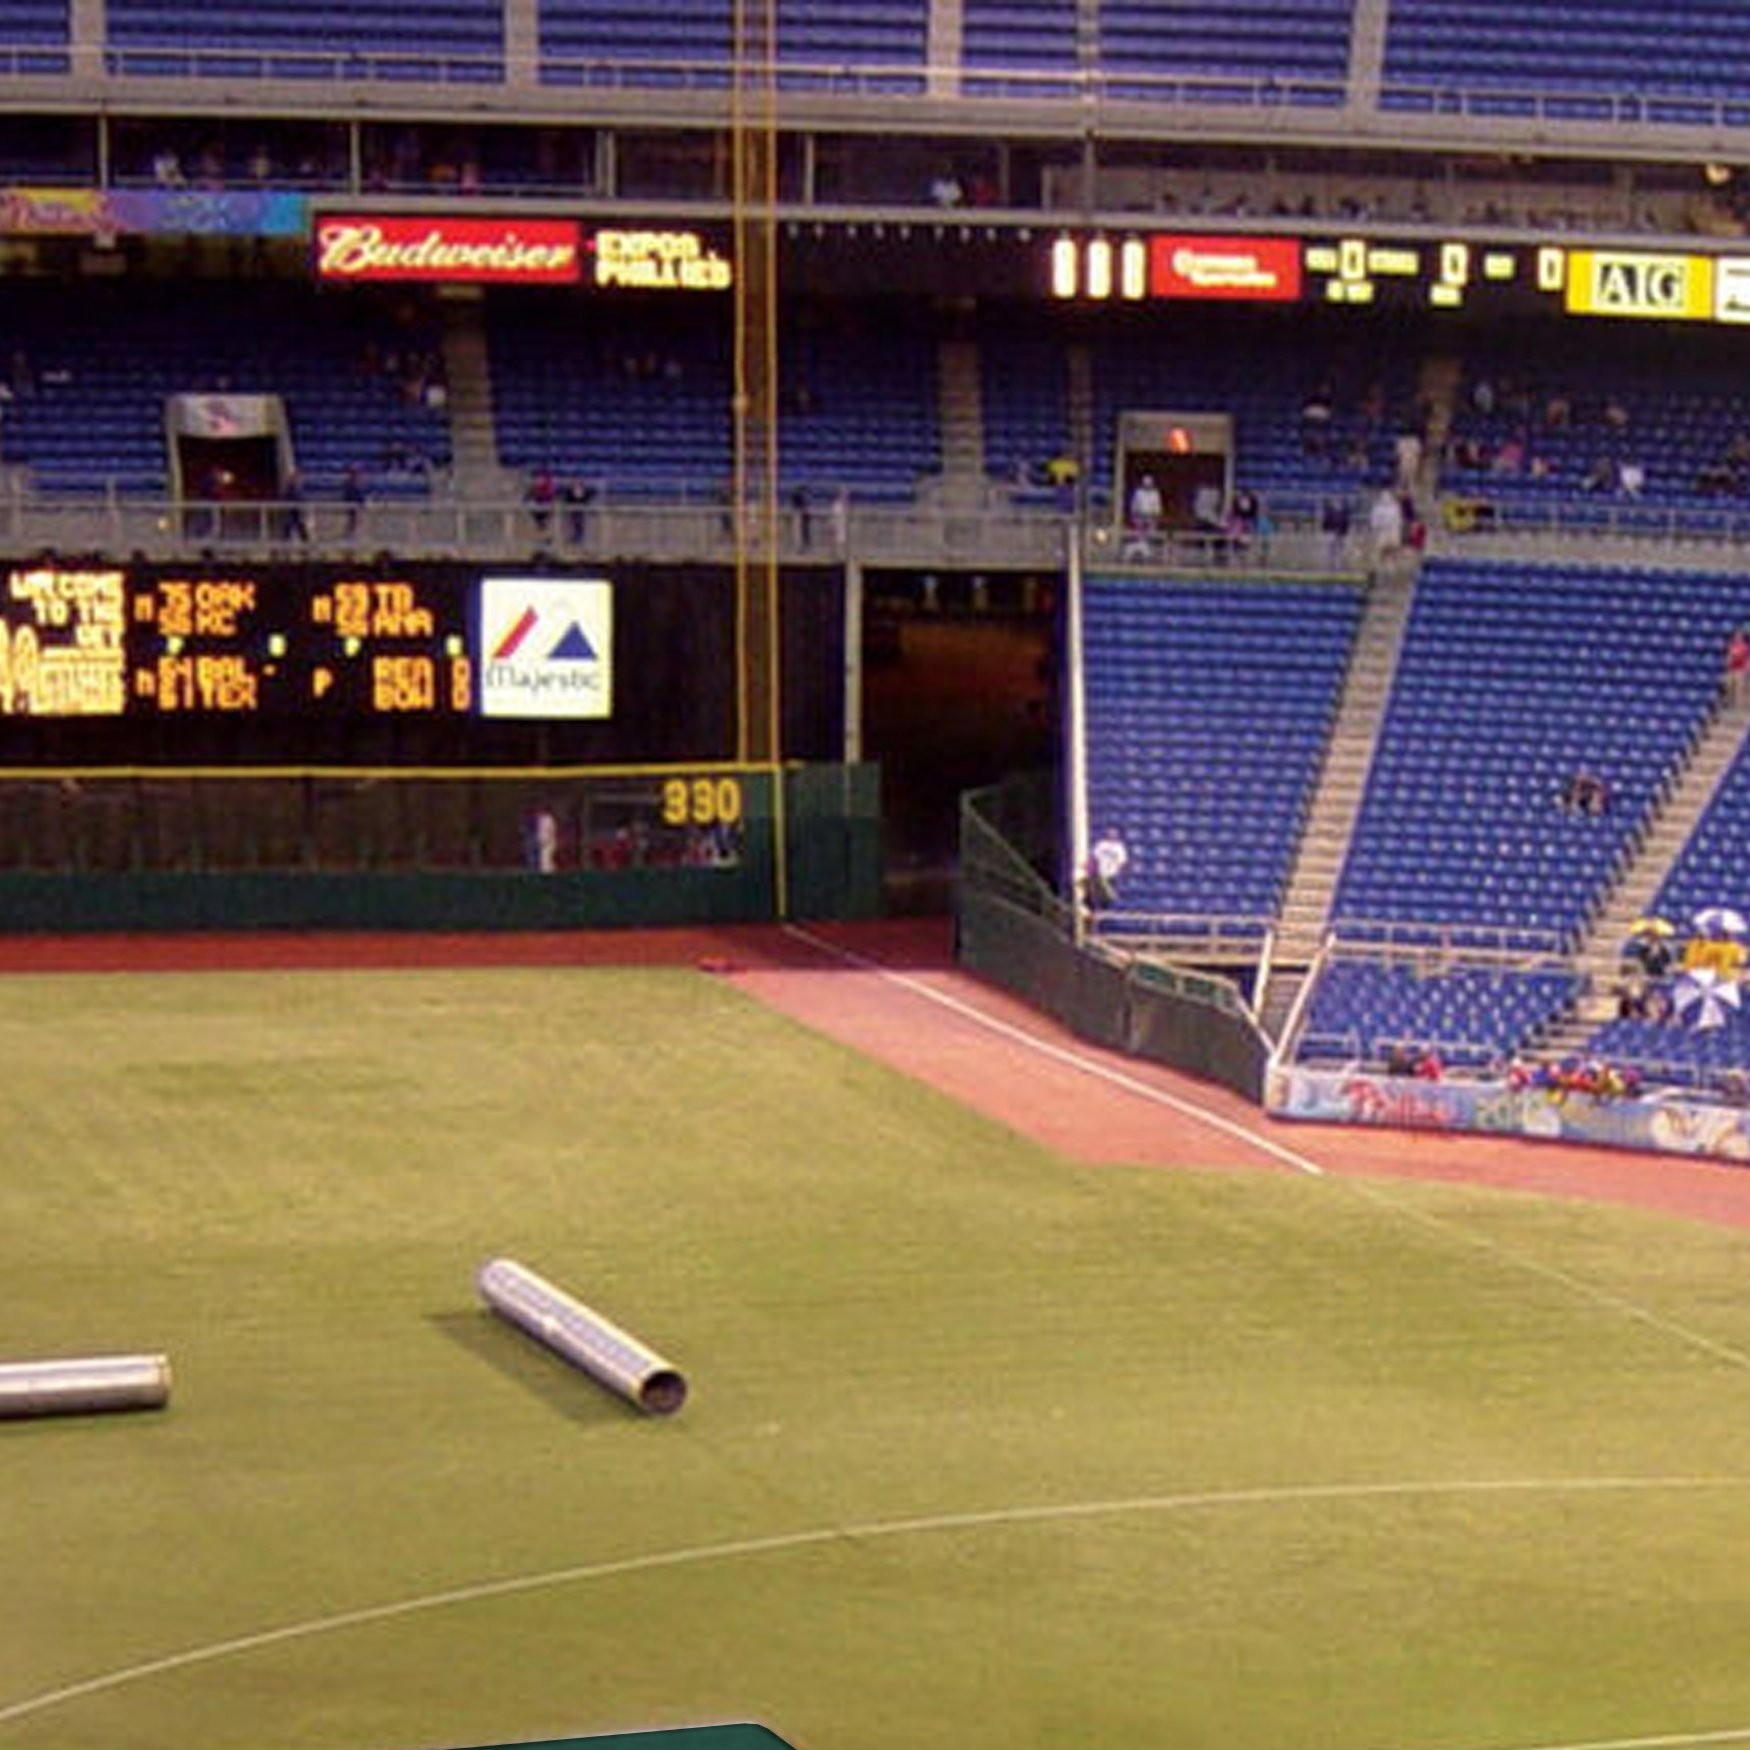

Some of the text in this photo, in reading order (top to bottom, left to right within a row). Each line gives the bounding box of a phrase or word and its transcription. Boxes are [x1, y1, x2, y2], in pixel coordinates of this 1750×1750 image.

[318, 224, 576, 274] Budweiser
[1598, 261, 1686, 308] AIG
[486, 663, 599, 694] Majestic
[663, 778, 740, 826] 330
